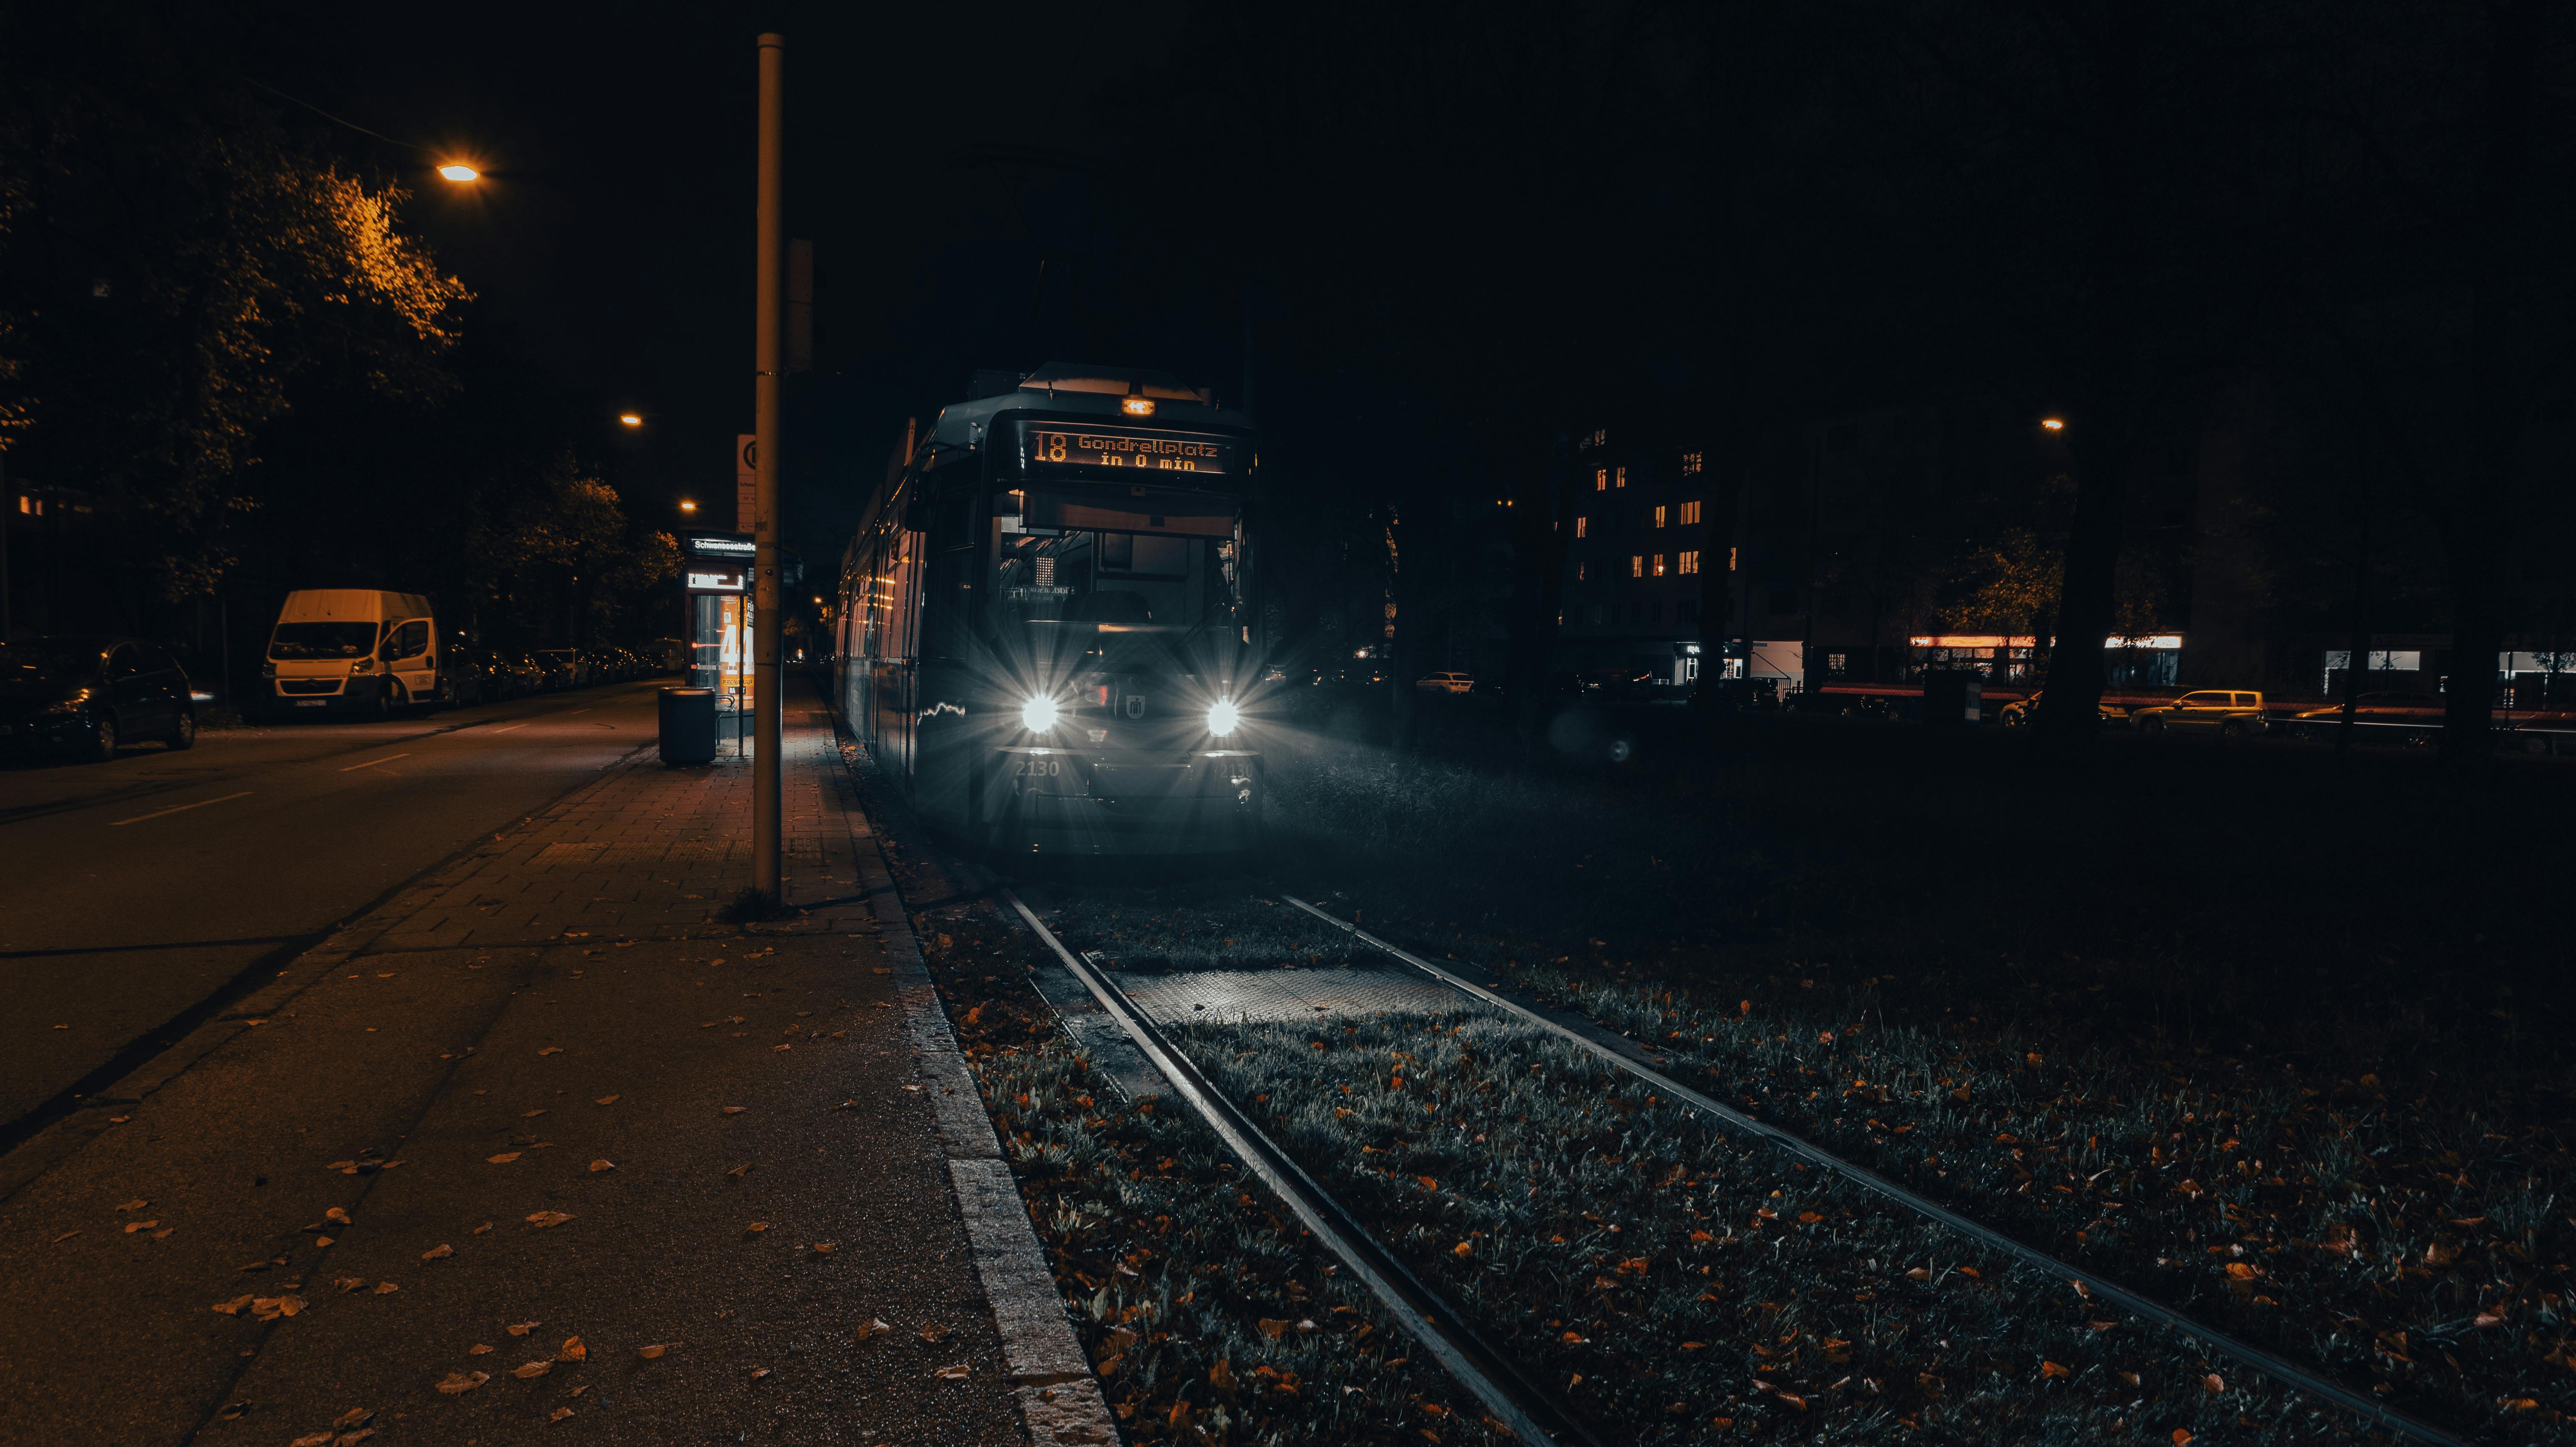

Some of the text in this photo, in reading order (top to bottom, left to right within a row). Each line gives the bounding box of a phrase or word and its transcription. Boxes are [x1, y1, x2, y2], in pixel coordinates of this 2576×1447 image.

[1035, 433, 1217, 461] 18 Gondrellplatz
[1101, 452, 1195, 471] in 0 min
[1016, 761, 1059, 777] 2130
[1220, 765, 1253, 778] 2130
